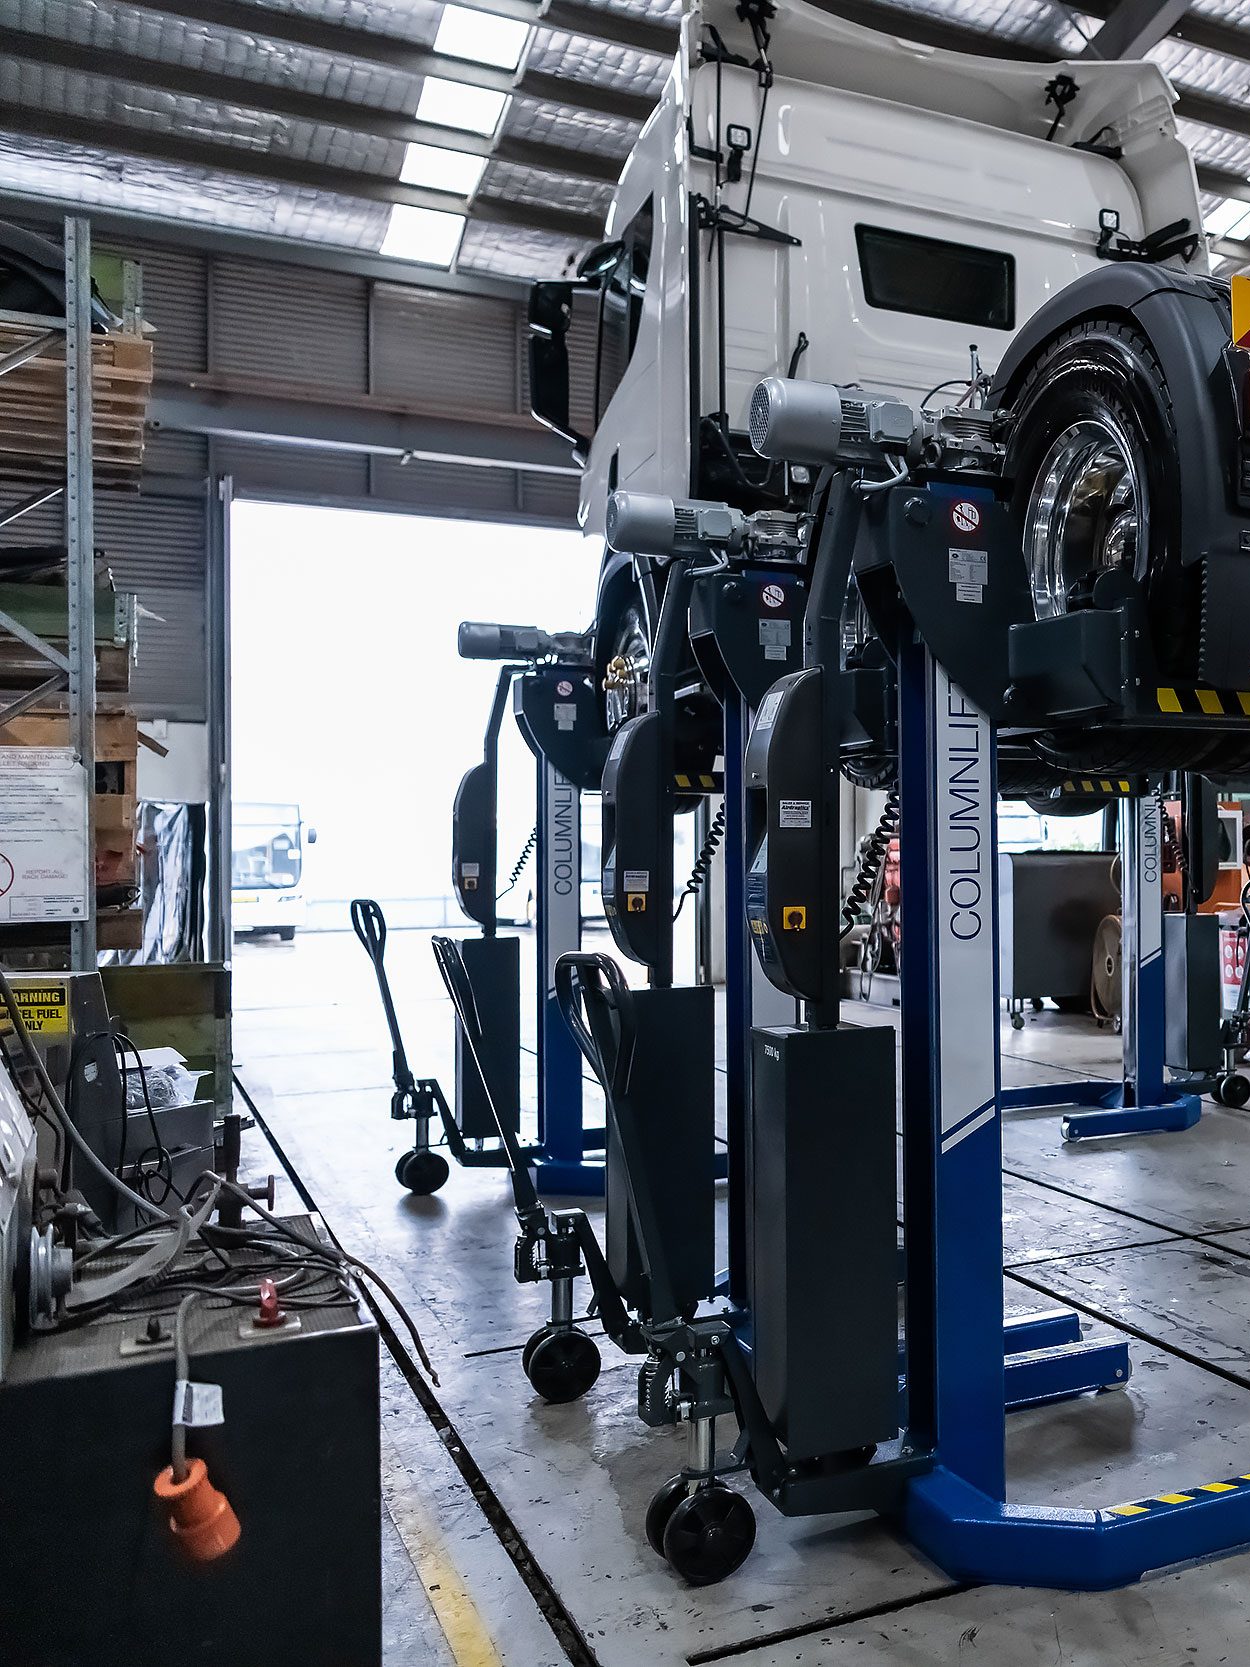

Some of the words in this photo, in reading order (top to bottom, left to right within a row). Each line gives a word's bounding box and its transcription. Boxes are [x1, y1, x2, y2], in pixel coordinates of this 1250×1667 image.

[554, 767, 573, 896] COLUMNLIF
[13, 992, 60, 1003] ARNING
[37, 1009, 62, 1018] FUEL
[25, 1020, 43, 1030] NLY
